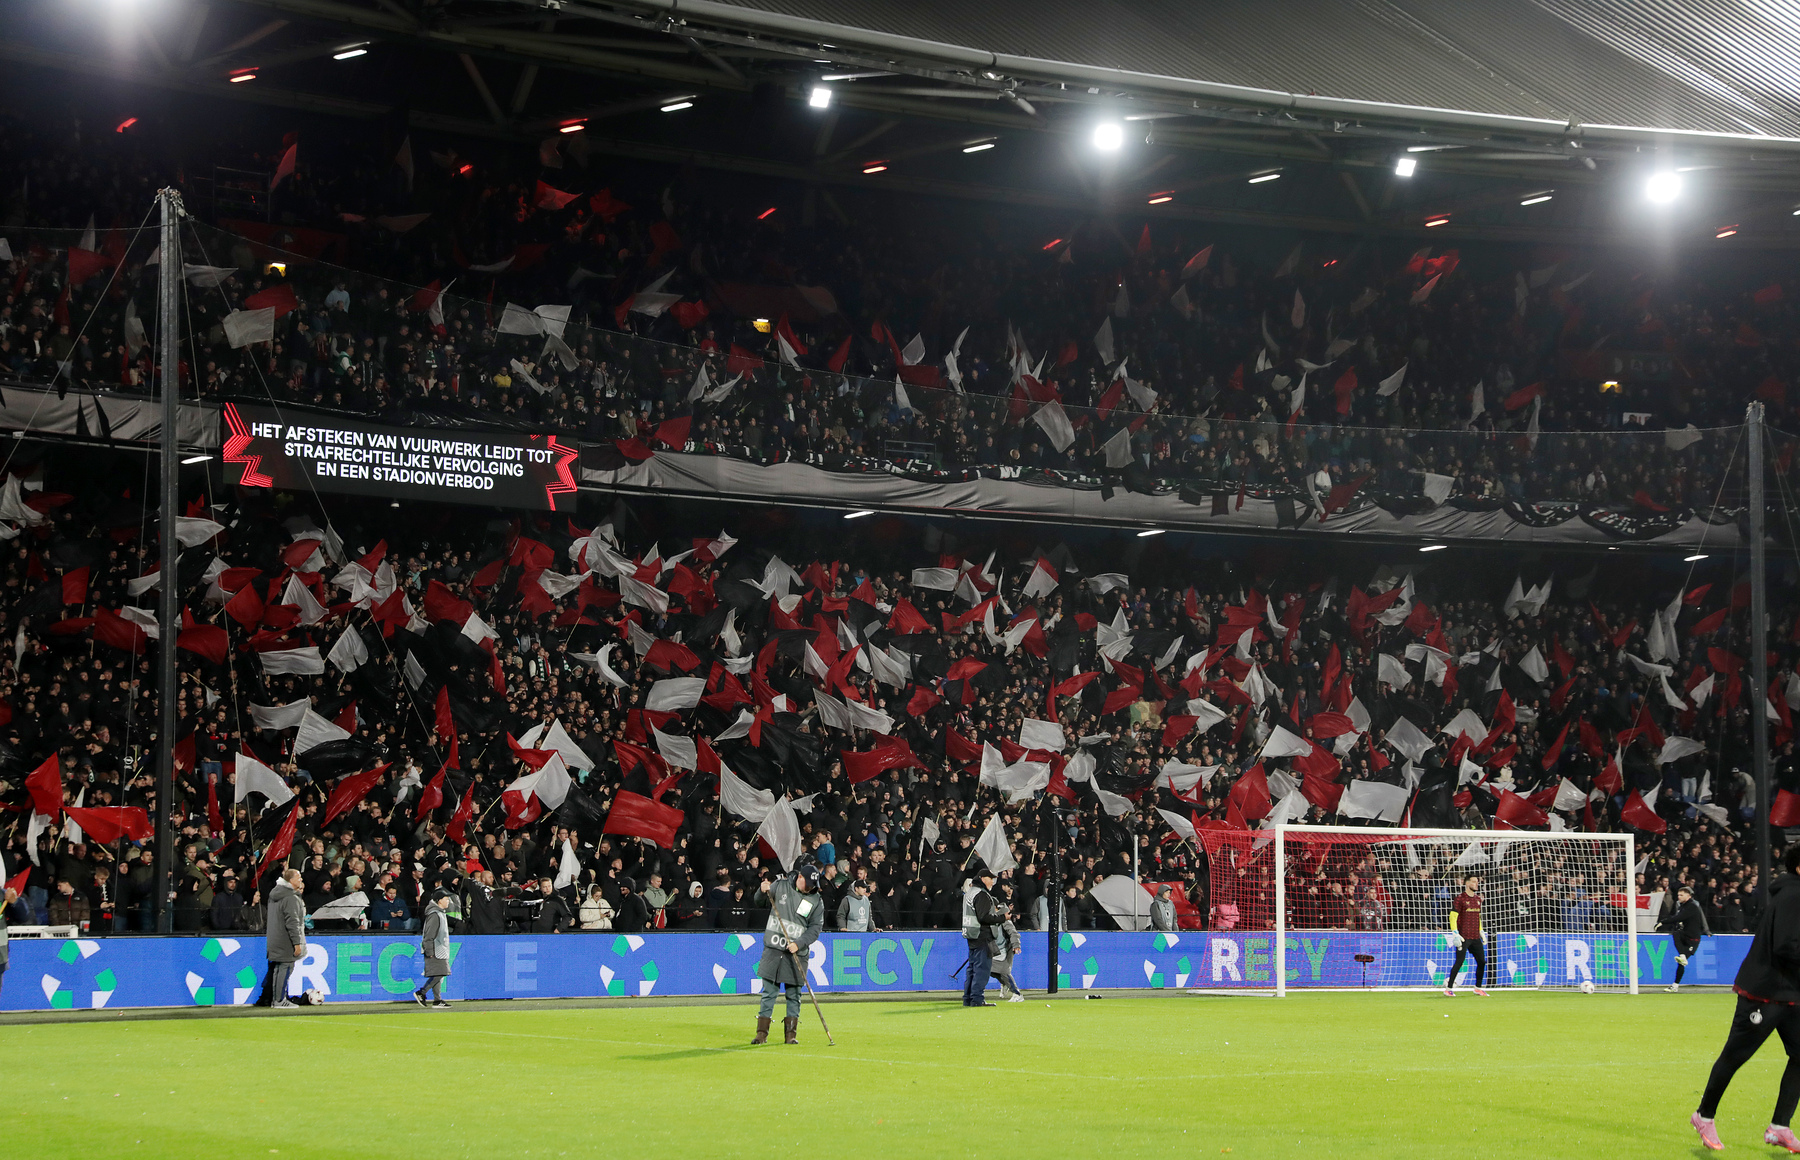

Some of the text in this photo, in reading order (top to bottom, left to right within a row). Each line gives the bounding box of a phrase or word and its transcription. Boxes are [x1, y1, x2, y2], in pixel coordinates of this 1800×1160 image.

[252, 422, 554, 464] HET AFSTEKEN VAN VUURWERK LEIDT TOT
[284, 442, 524, 478] STRAFRECHTELIJKE VERVOLGING
[316, 461, 494, 490] EN EEN STADIONVERBOD
[771, 934, 794, 948] 00
[1211, 938, 1330, 982] RECY
[1565, 939, 1669, 981] RECY
